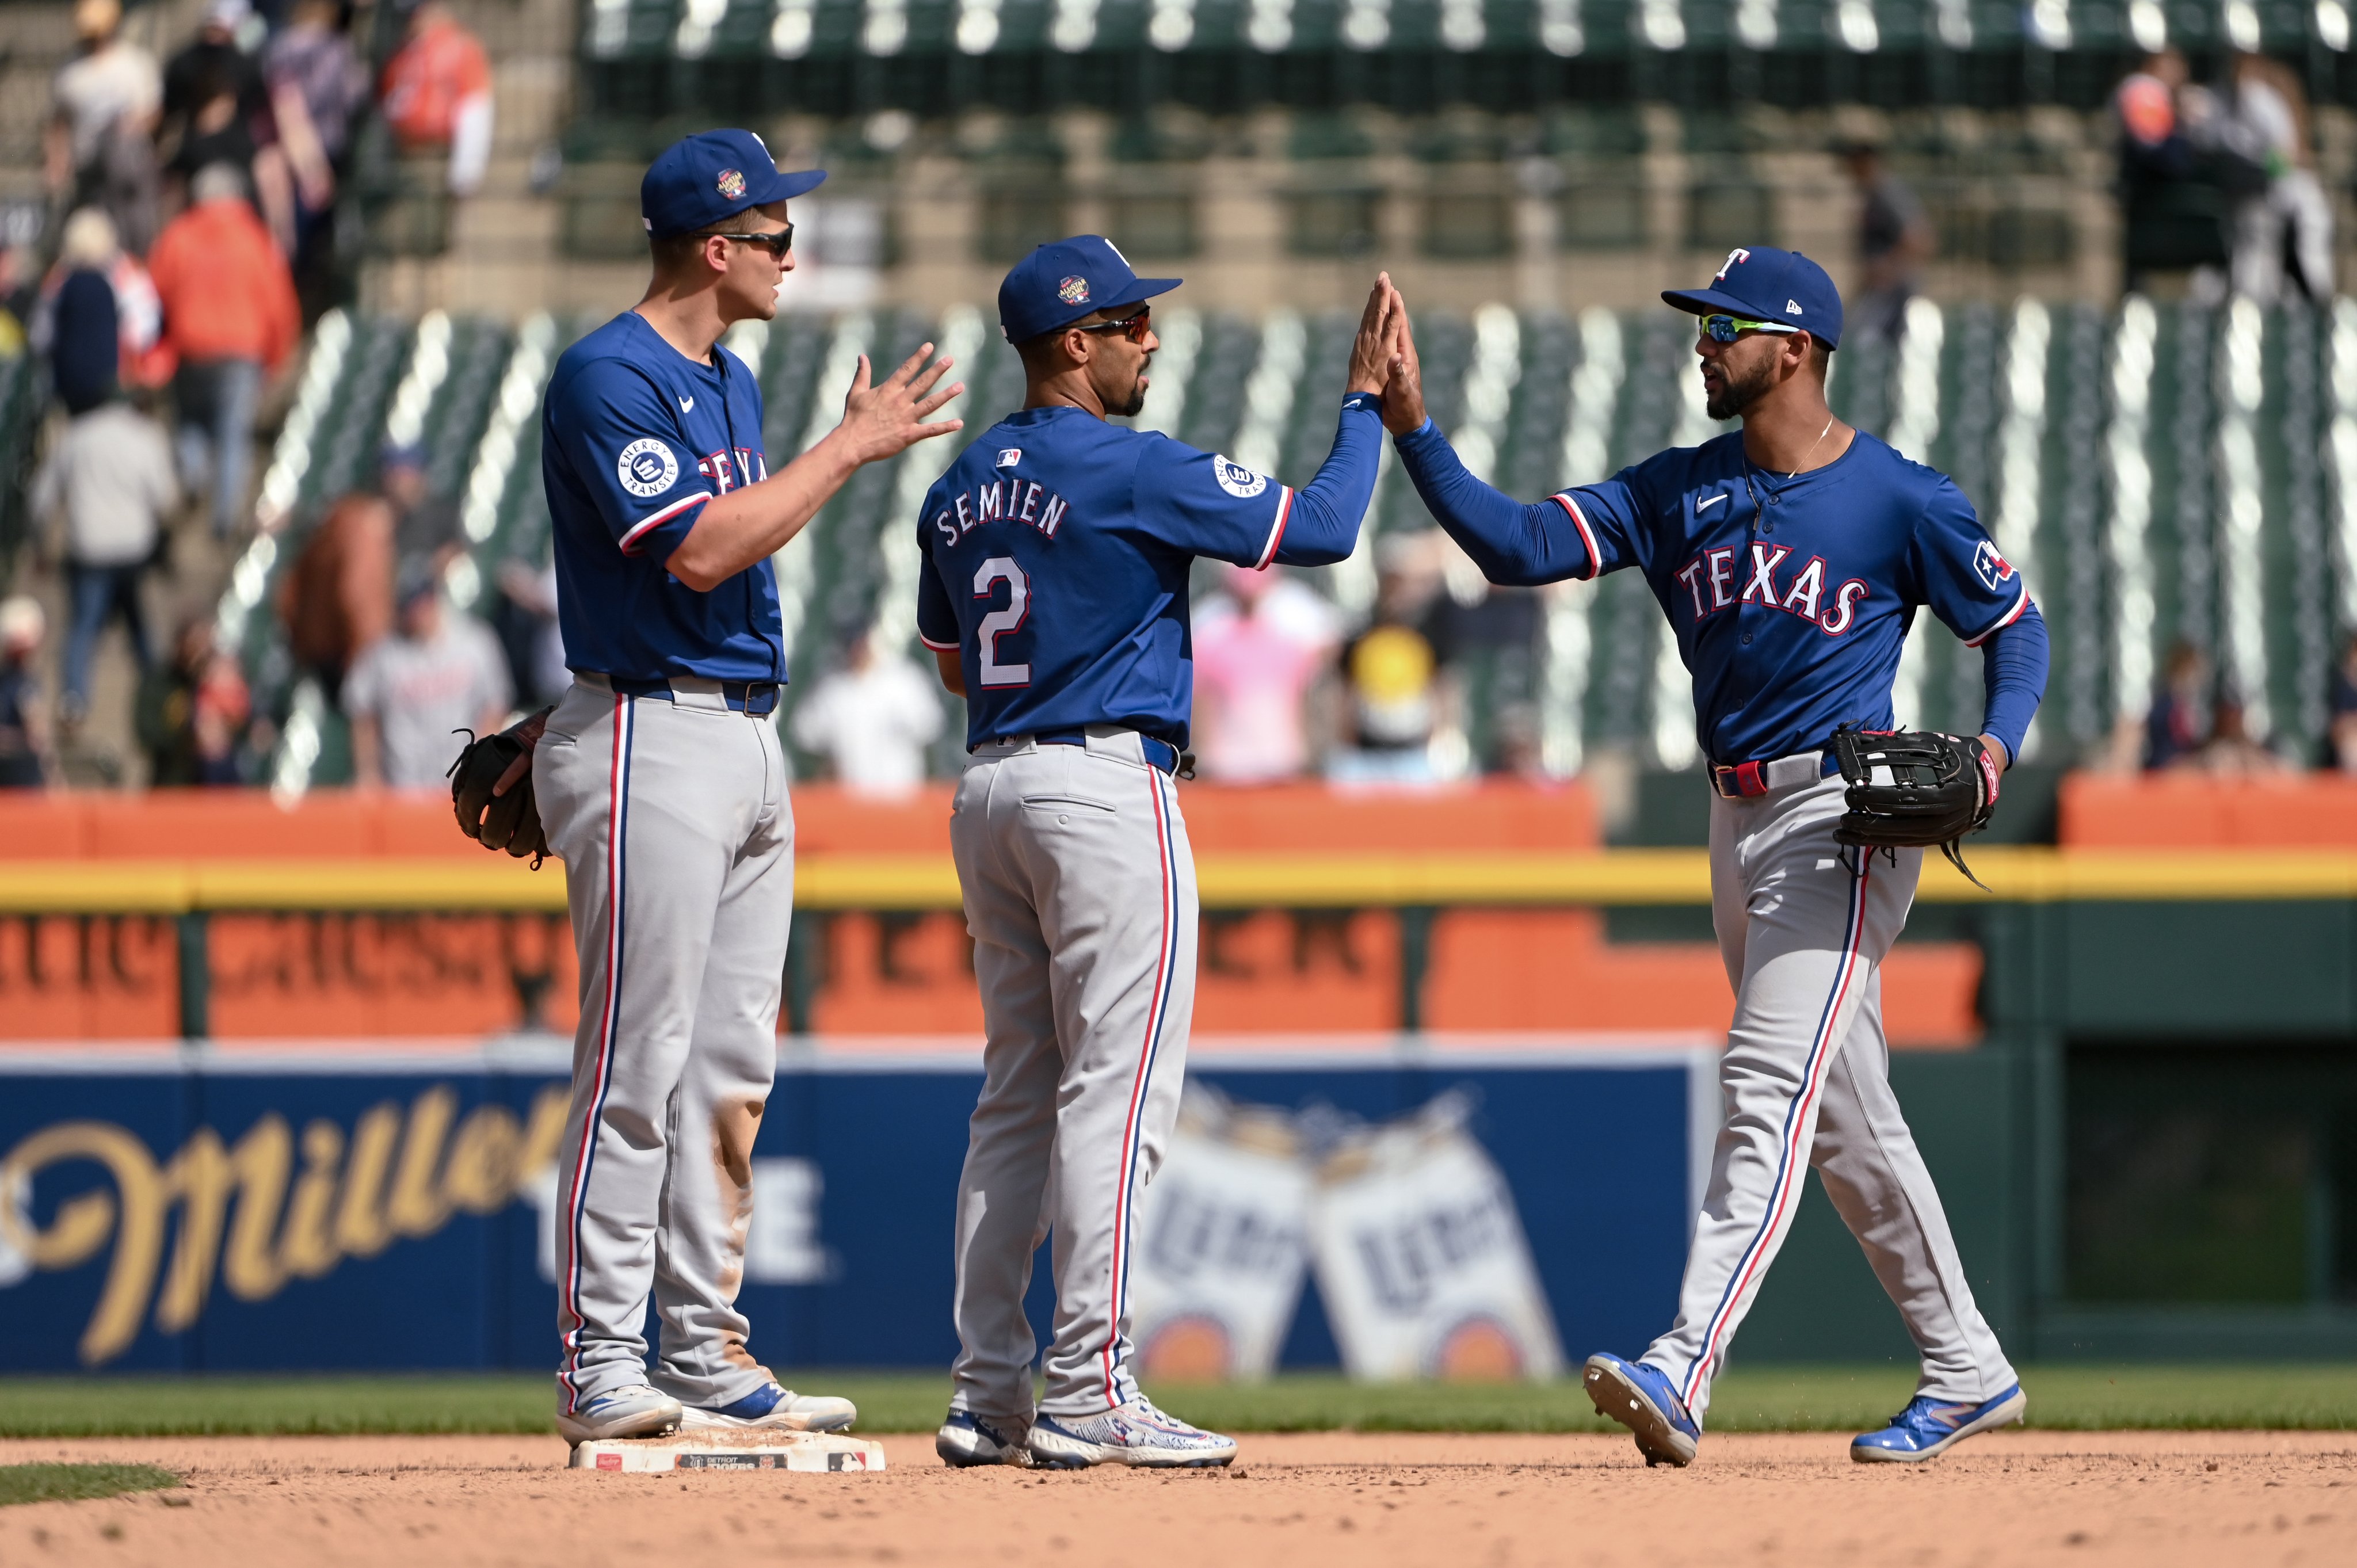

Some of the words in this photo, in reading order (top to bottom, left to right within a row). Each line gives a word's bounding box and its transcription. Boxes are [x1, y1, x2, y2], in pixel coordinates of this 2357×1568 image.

[620, 441, 668, 468] ENERGY
[624, 462, 676, 495] TRANSFER
[937, 479, 1070, 546] SEMIEN
[973, 555, 1031, 689] 2
[1673, 541, 1869, 636] TEXAS
